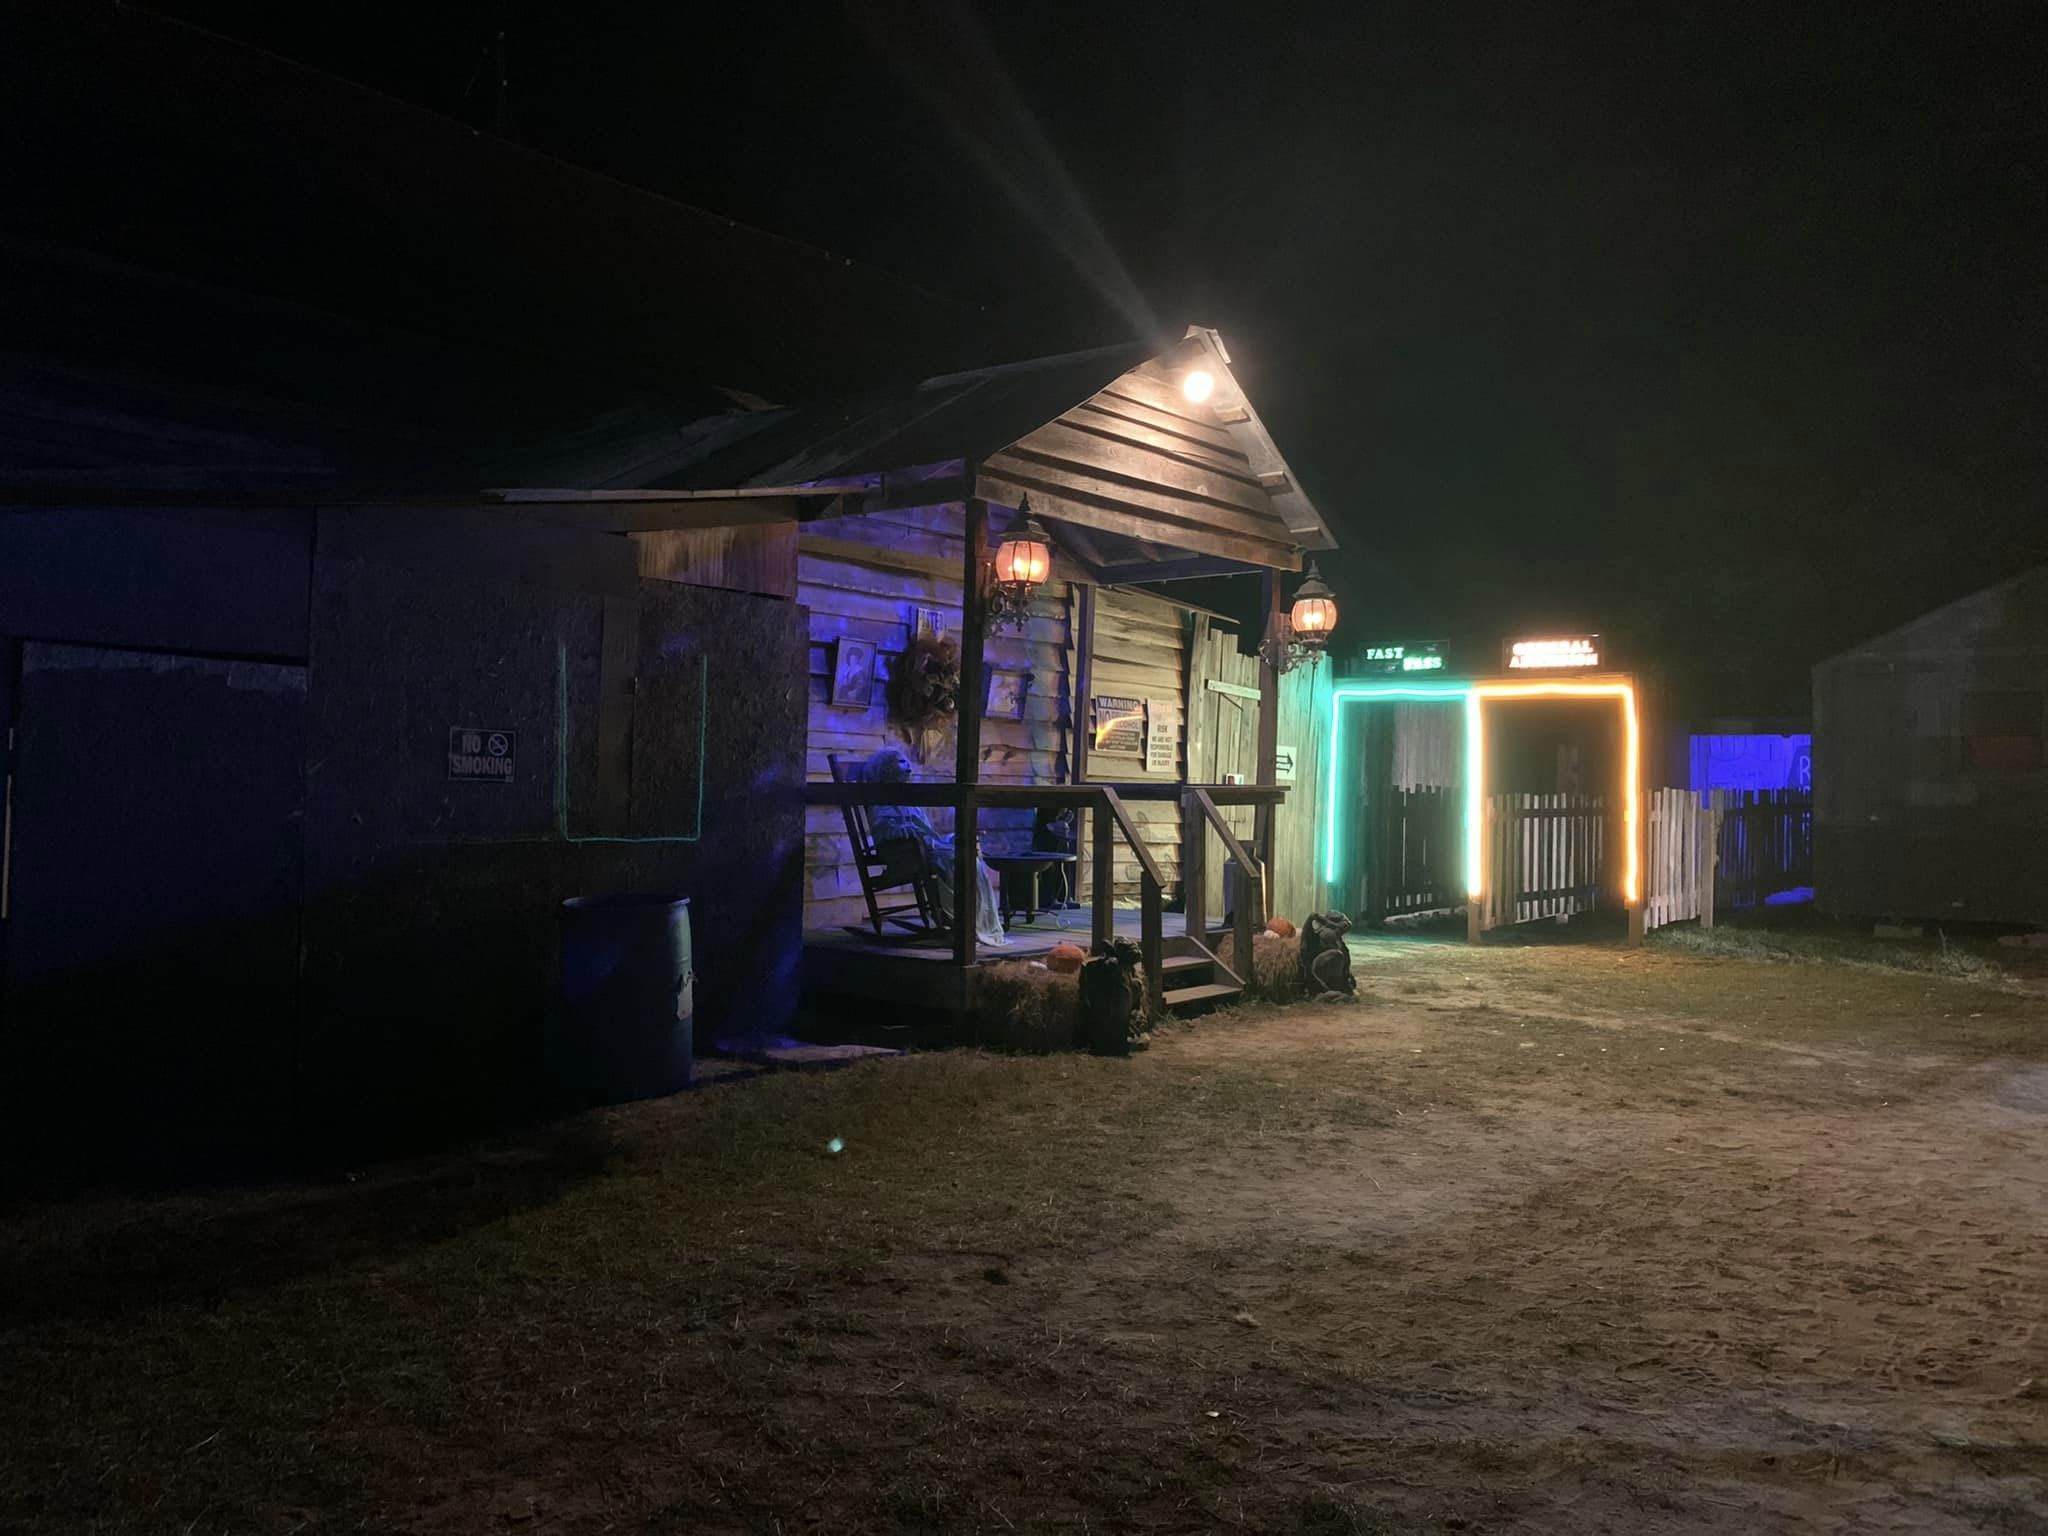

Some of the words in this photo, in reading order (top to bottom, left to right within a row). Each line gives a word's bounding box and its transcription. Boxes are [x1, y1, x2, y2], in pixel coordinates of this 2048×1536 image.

[1366, 646, 1404, 660] FAST
[1403, 656, 1442, 671] PASS
[1098, 698, 1138, 711] WARNING
[462, 734, 482, 753] NO
[452, 754, 513, 775] SMOKING
